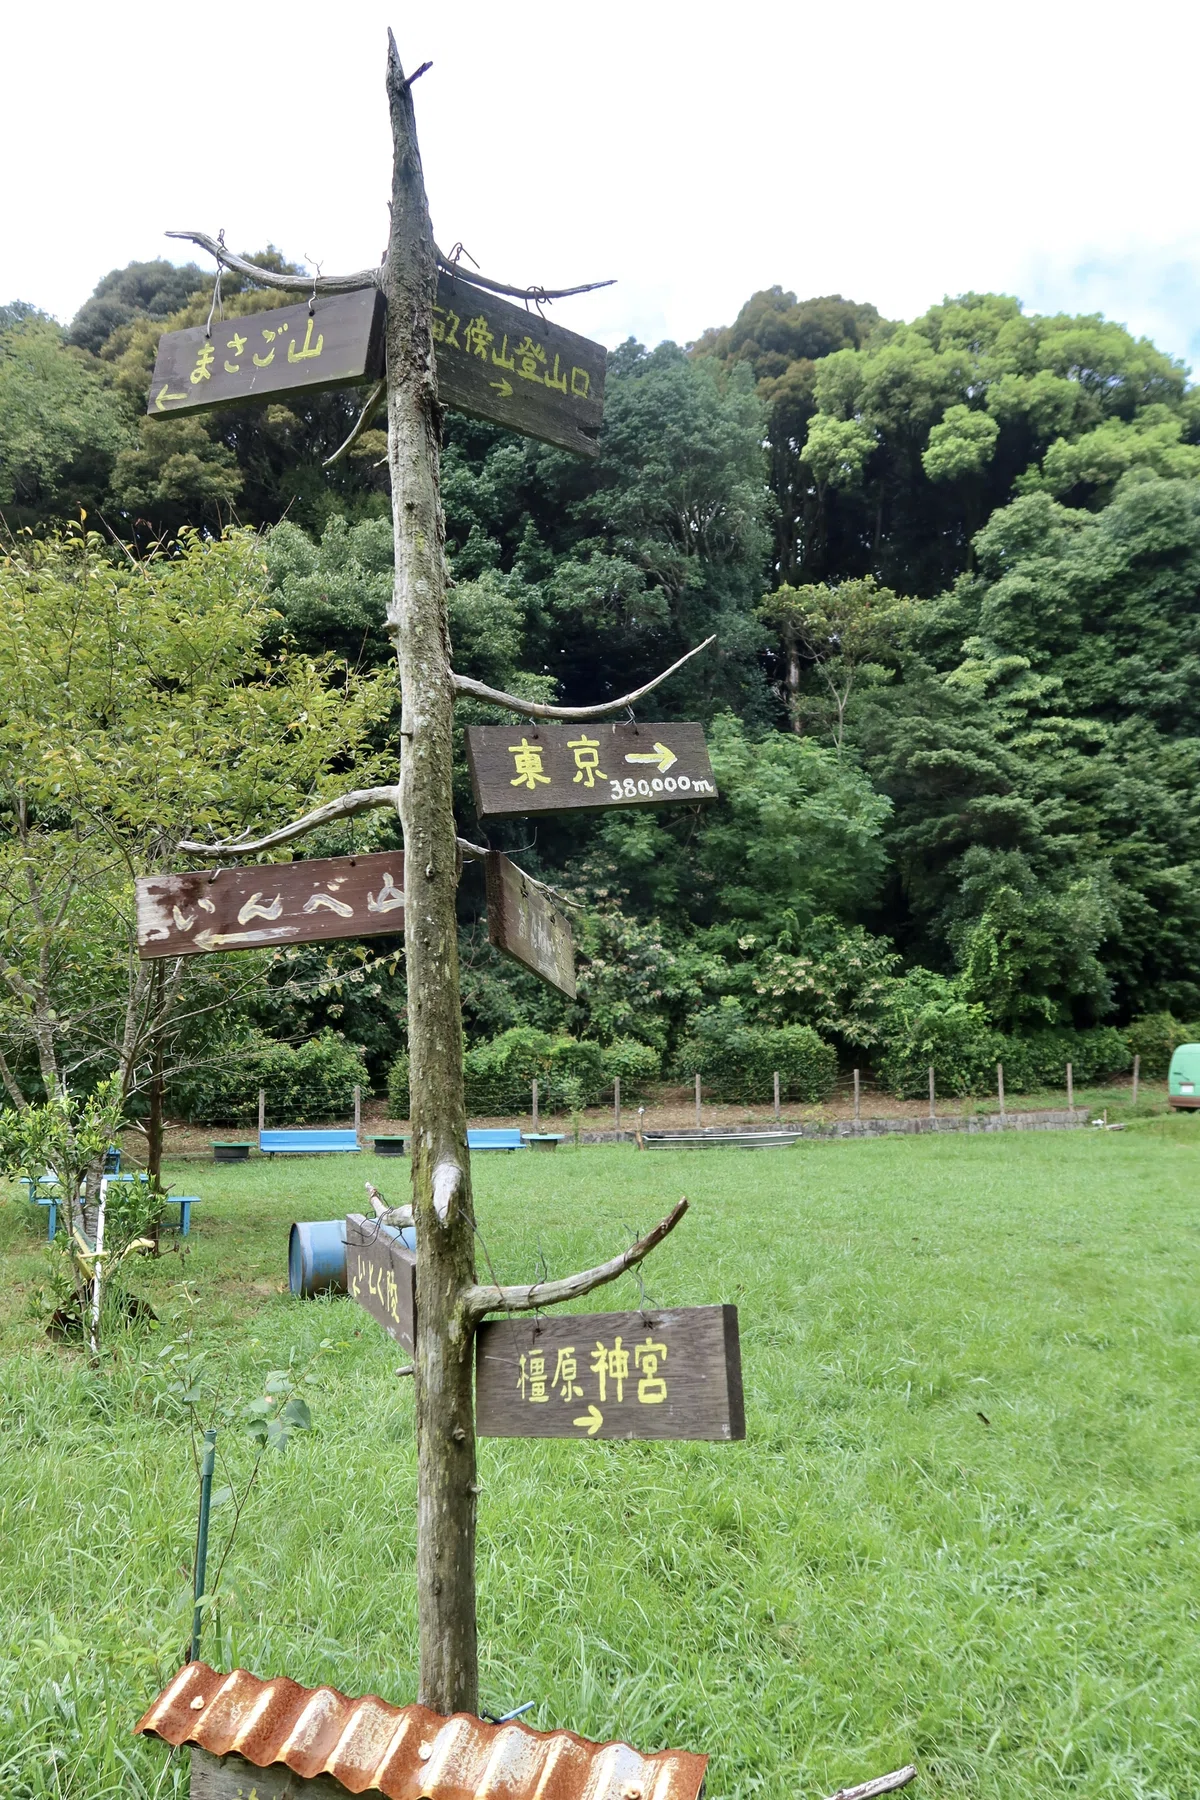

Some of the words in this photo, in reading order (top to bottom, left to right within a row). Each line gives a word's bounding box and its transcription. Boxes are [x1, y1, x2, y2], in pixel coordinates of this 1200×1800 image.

[189, 318, 324, 384] まさご山
[508, 734, 608, 790] 東京
[610, 775, 714, 800] 380,000m
[516, 1336, 668, 1404] 橿原神宮
